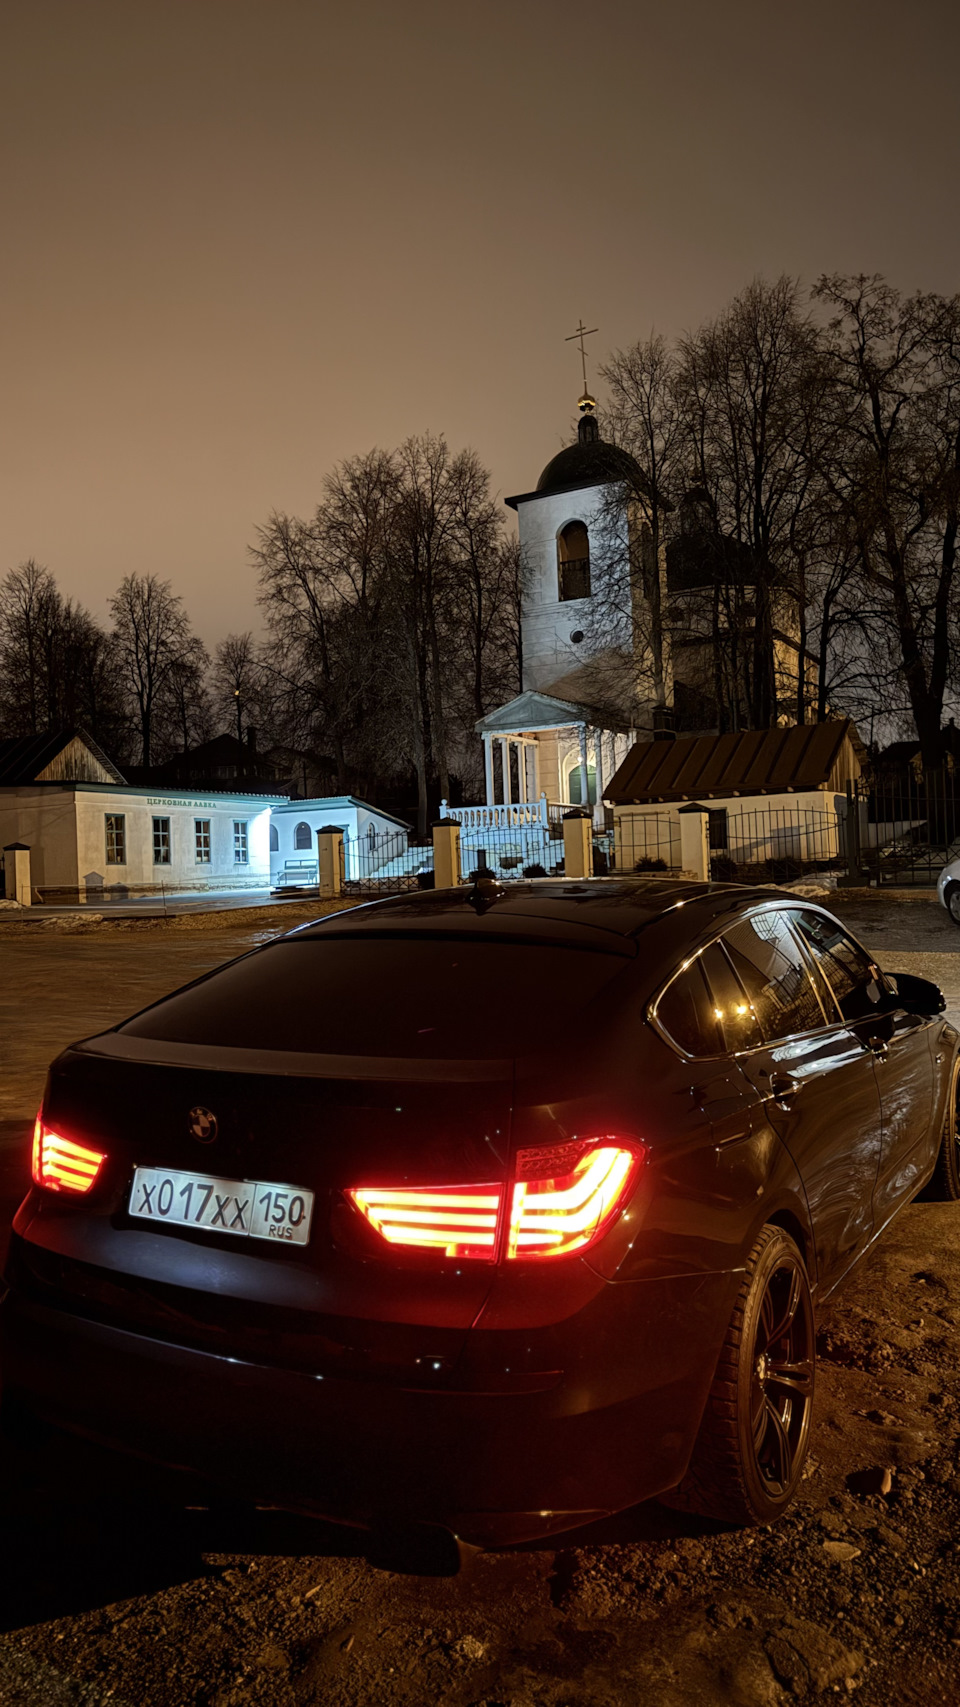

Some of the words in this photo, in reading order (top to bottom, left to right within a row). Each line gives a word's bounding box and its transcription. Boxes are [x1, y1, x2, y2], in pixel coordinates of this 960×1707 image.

[146, 798, 192, 807] ЦЕРКОВНАЯ
[259, 1191, 304, 1226] 150
[268, 1225, 293, 1240] RUS
